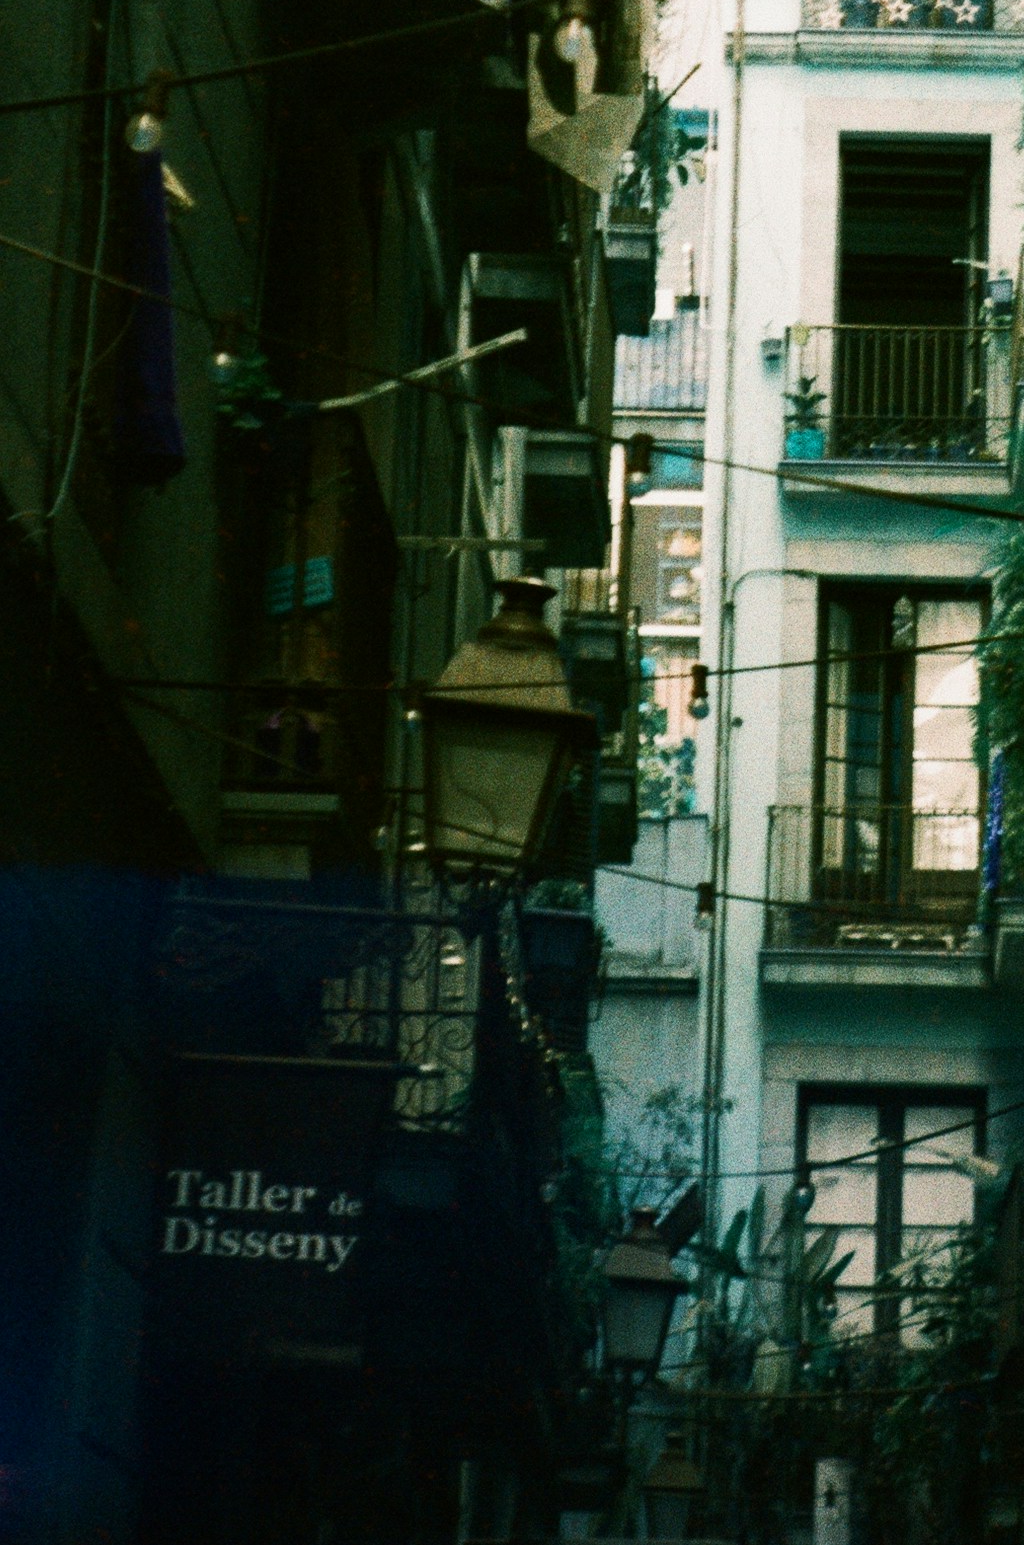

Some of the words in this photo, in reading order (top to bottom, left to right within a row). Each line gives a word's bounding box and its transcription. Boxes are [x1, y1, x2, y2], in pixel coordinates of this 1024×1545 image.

[168, 1170, 317, 1213] Taller
[328, 1192, 362, 1216] de
[161, 1216, 358, 1272] Disseny
